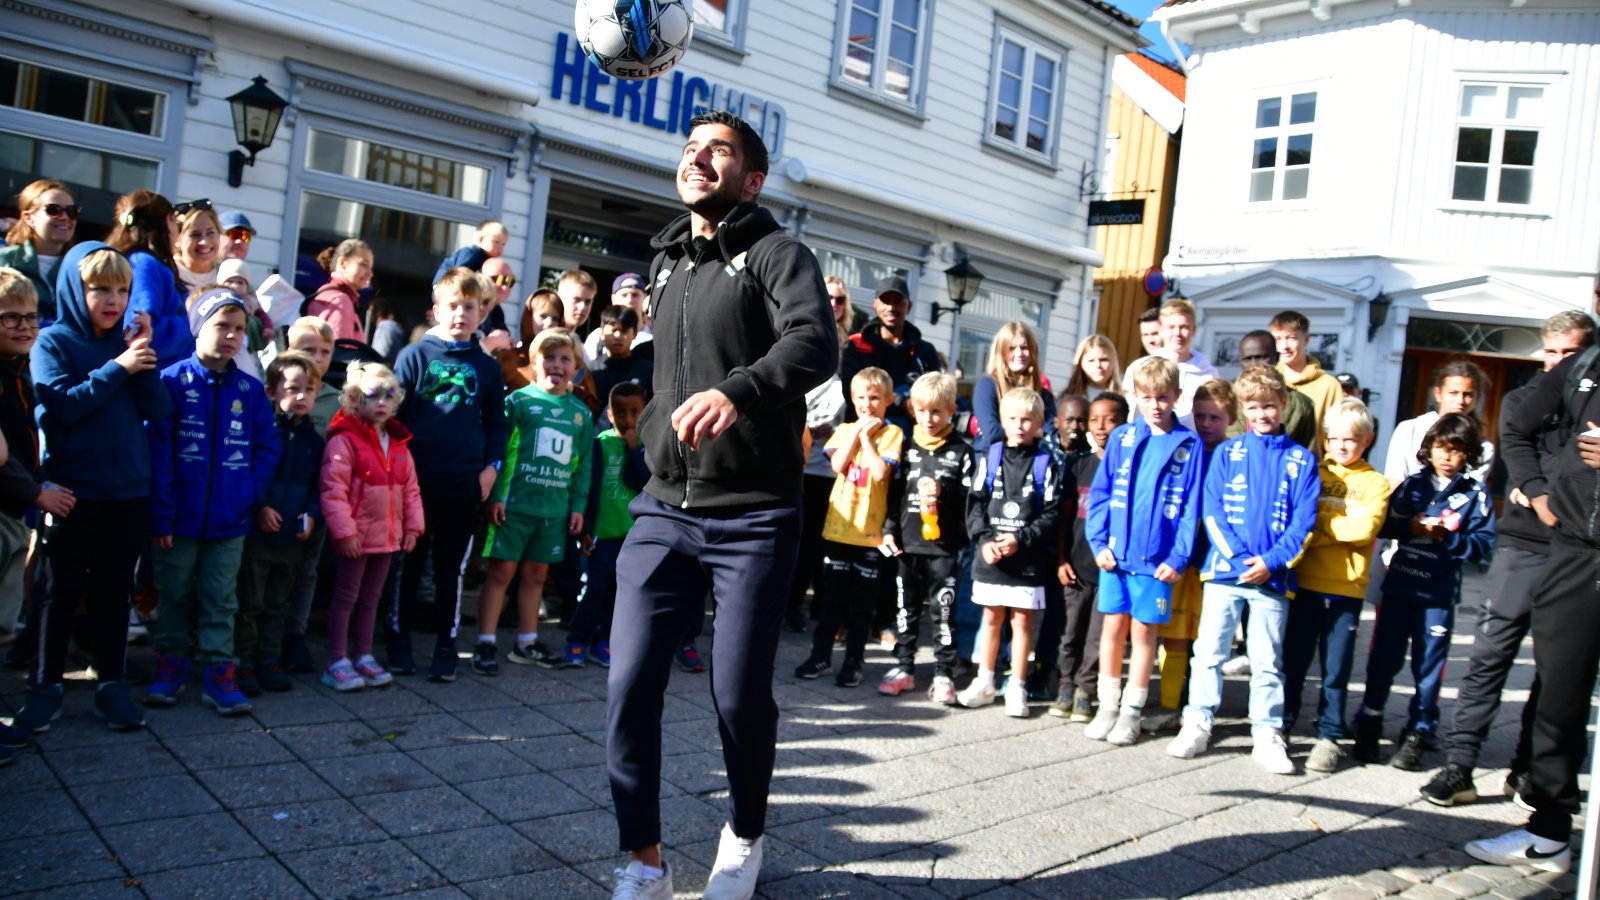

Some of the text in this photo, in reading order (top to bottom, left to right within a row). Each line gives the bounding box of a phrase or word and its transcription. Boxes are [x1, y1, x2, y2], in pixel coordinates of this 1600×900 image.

[615, 54, 677, 78] SELECT
[551, 437, 565, 454] U
[520, 463, 537, 473] The
